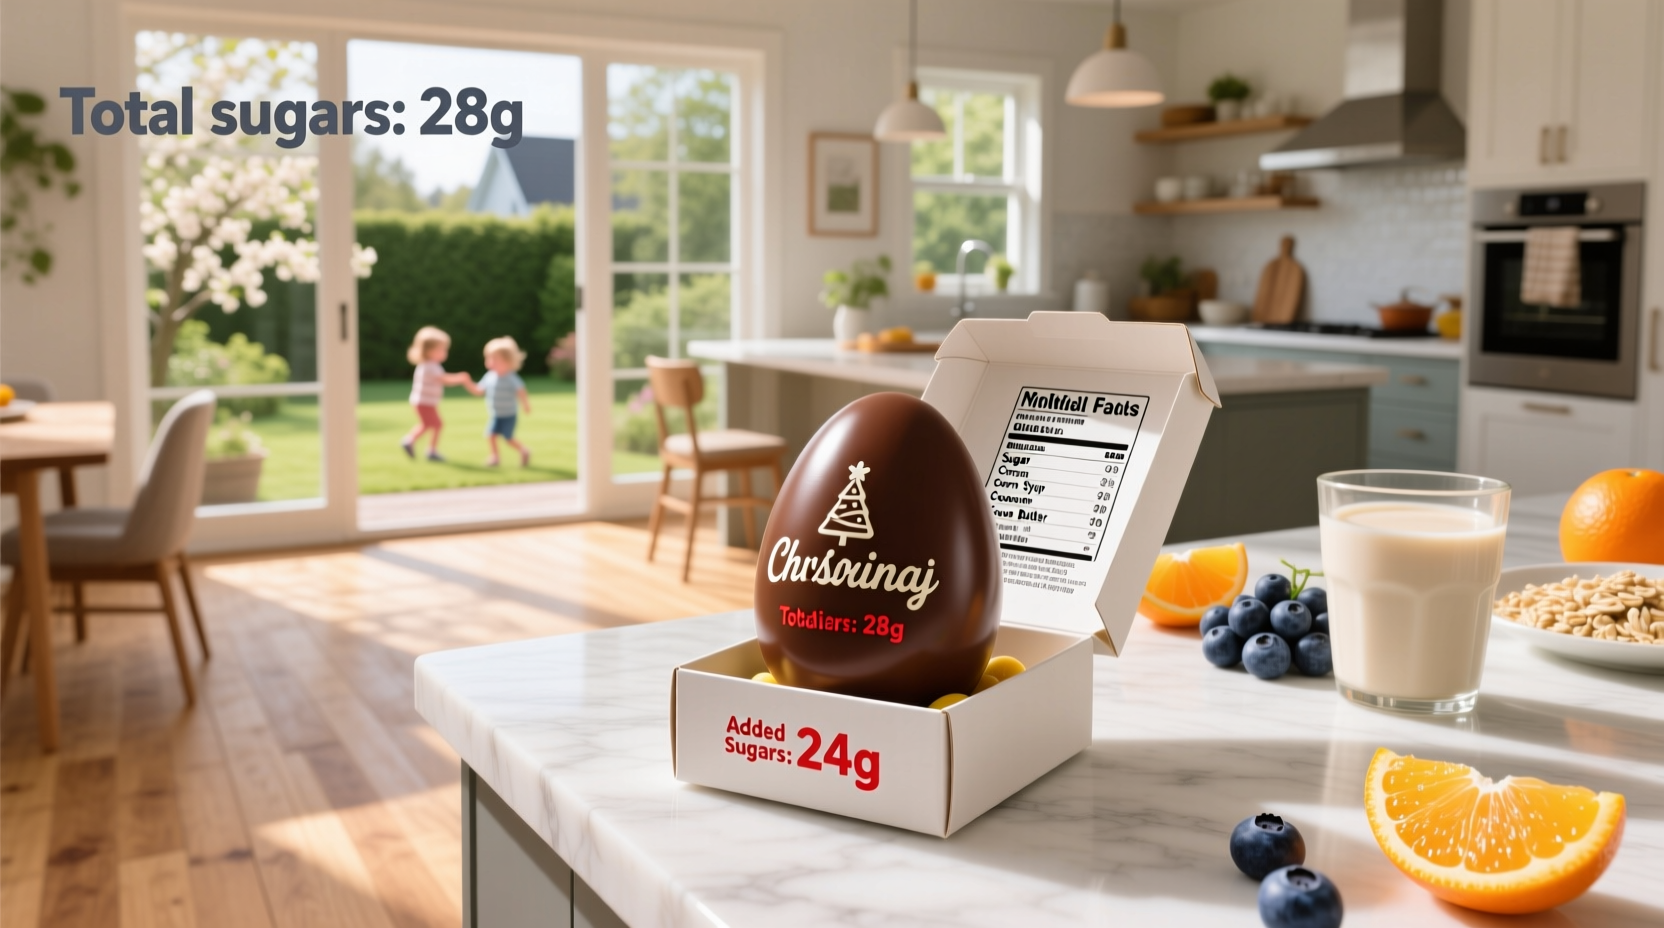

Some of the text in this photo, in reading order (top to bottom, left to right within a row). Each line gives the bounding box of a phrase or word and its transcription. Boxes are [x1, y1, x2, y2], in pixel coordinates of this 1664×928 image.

[863, 614, 904, 643] 28g
[726, 715, 785, 742] Added
[725, 736, 792, 765] Sugars:
[797, 726, 880, 791] 24g
